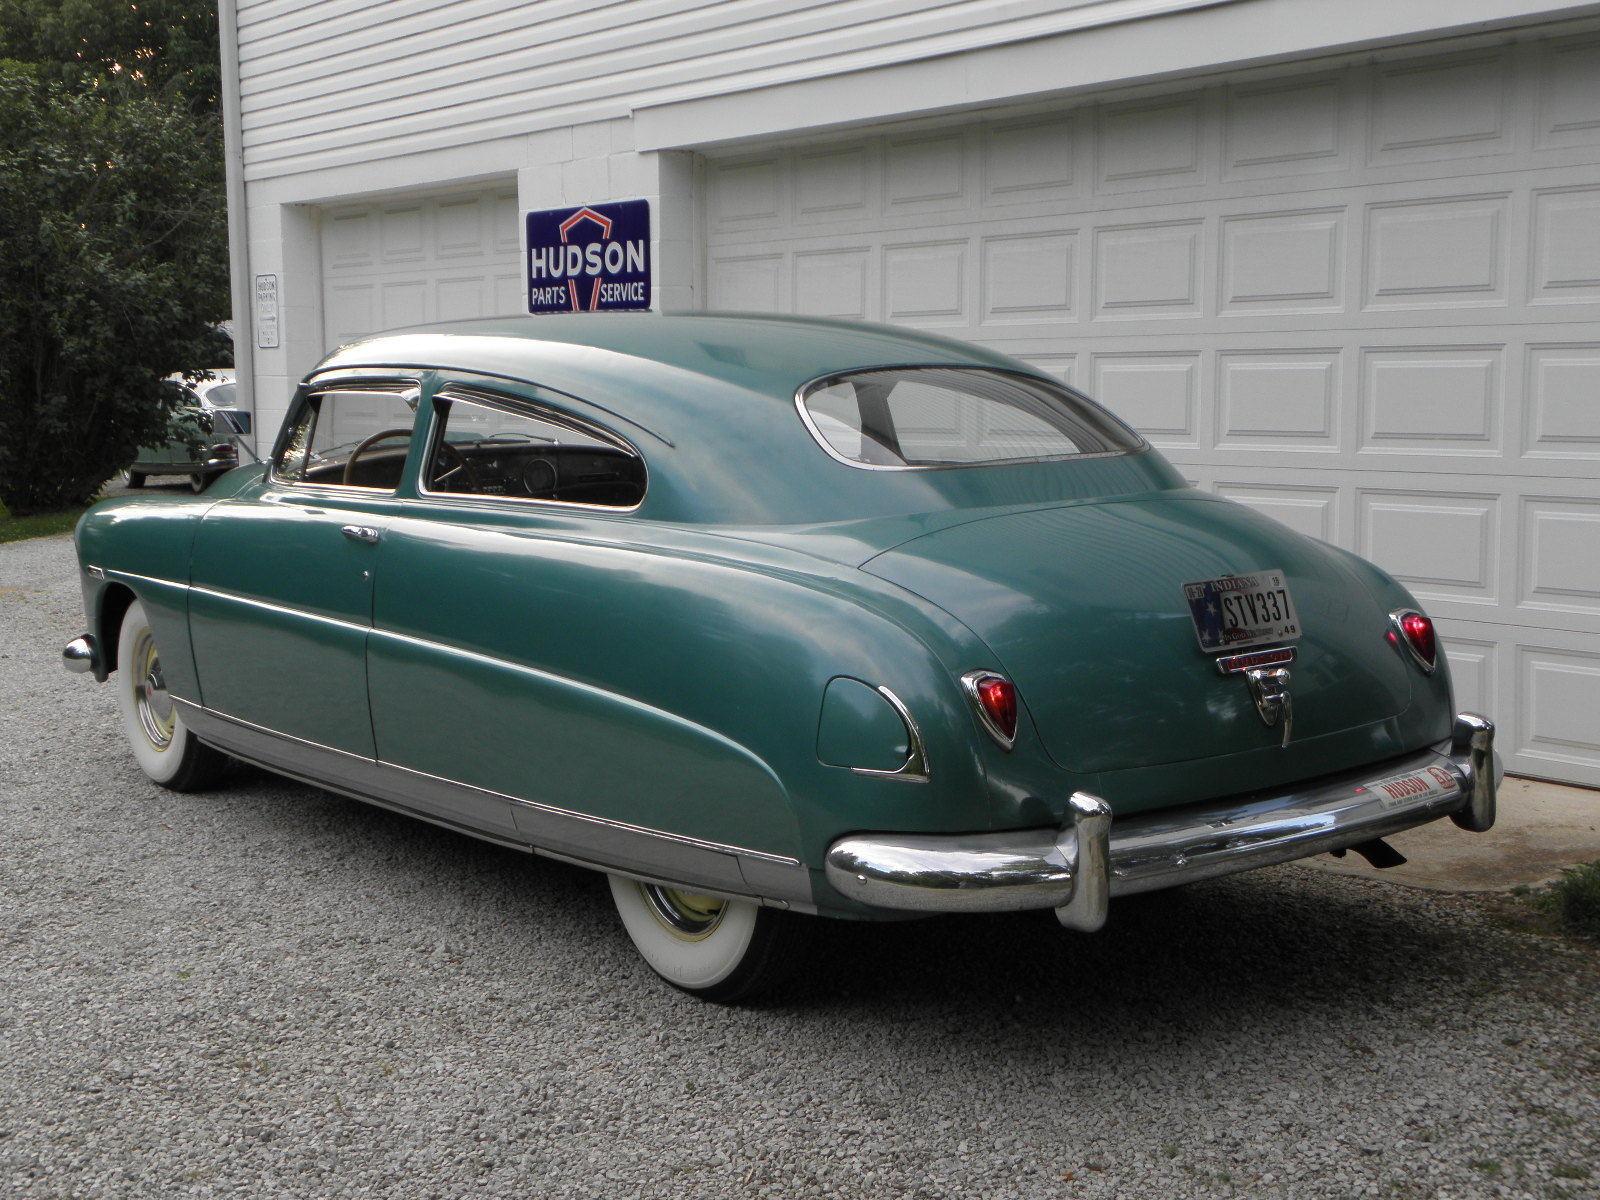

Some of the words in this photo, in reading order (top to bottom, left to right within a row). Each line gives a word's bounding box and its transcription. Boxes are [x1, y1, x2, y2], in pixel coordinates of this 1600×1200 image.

[531, 239, 645, 279] HUDSON
[532, 286, 566, 305] PARTS
[600, 281, 645, 303] SERVICE
[1209, 575, 1261, 593] INDIANA
[1223, 589, 1291, 628] STV337
[1284, 624, 1297, 635] 49
[1380, 776, 1431, 800] HUDSON
